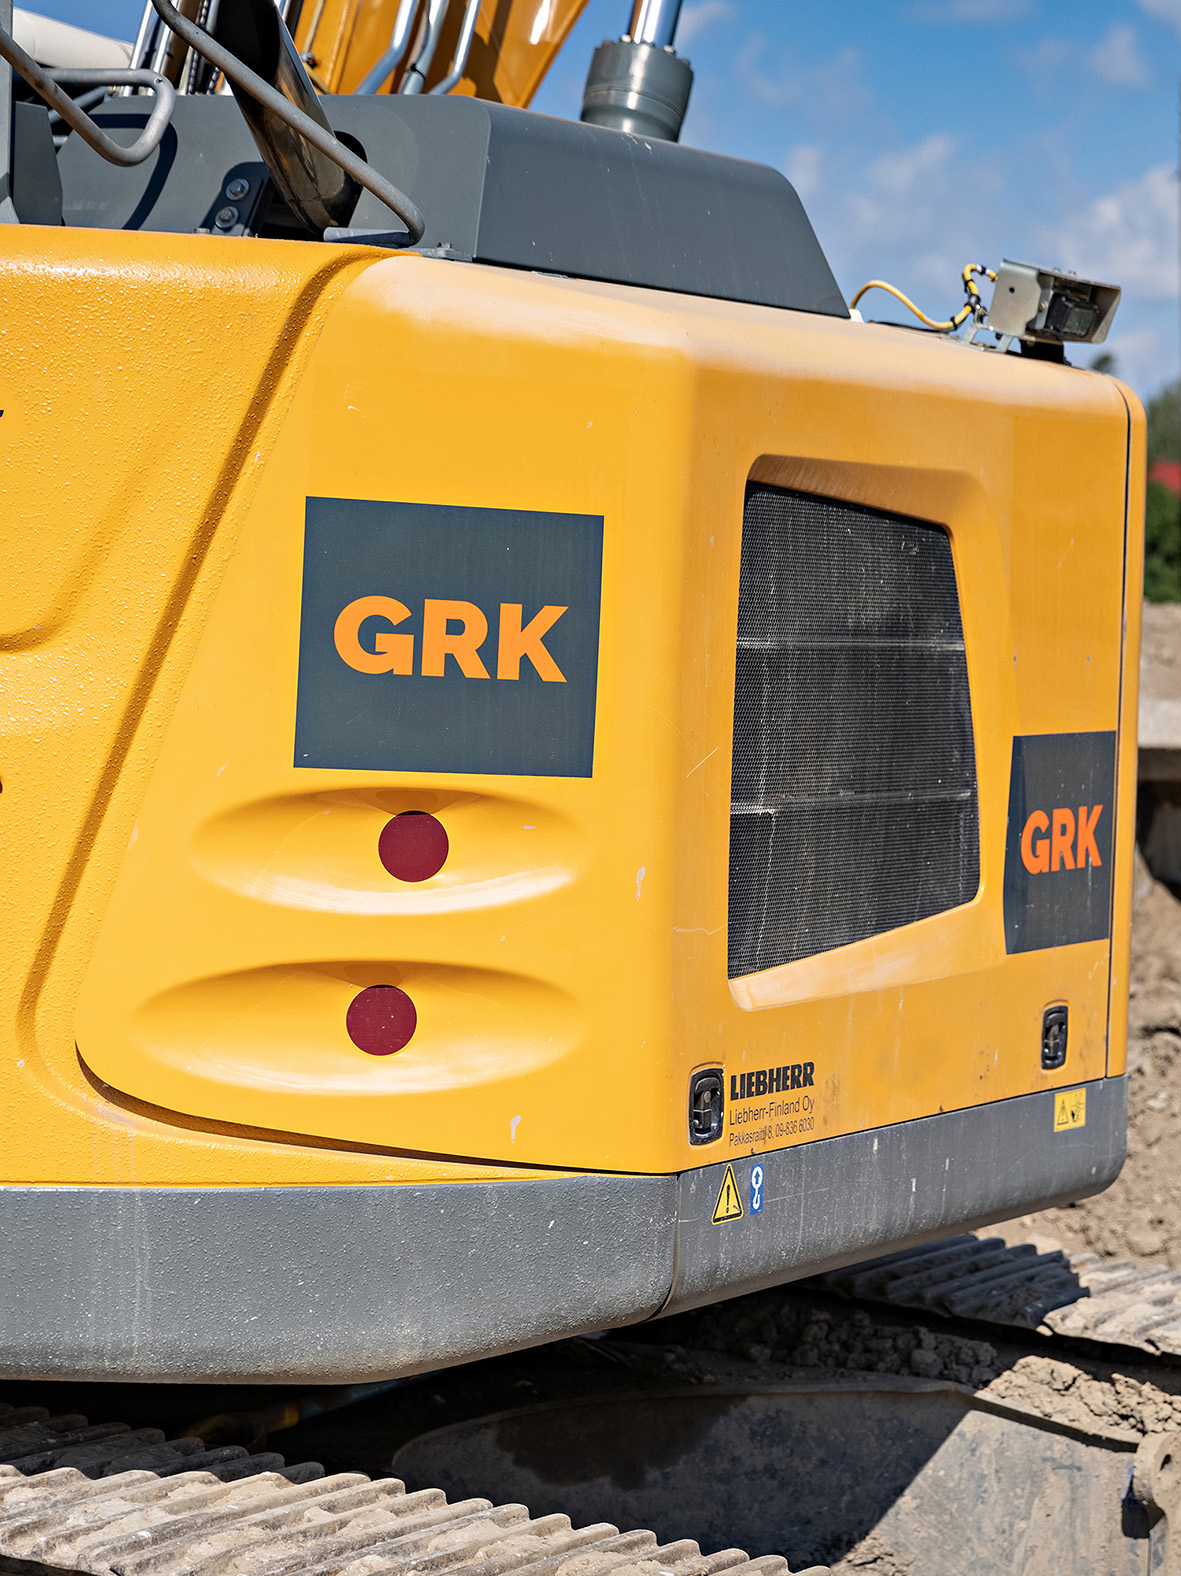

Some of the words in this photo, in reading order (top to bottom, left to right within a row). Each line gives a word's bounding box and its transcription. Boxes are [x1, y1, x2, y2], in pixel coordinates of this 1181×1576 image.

[333, 595, 569, 683] GRK
[1020, 804, 1104, 875] GRK
[730, 1061, 815, 1101] LIEBHERR
[729, 1097, 800, 1126] Liebherr-Finland
[802, 1095, 815, 1114] Oy
